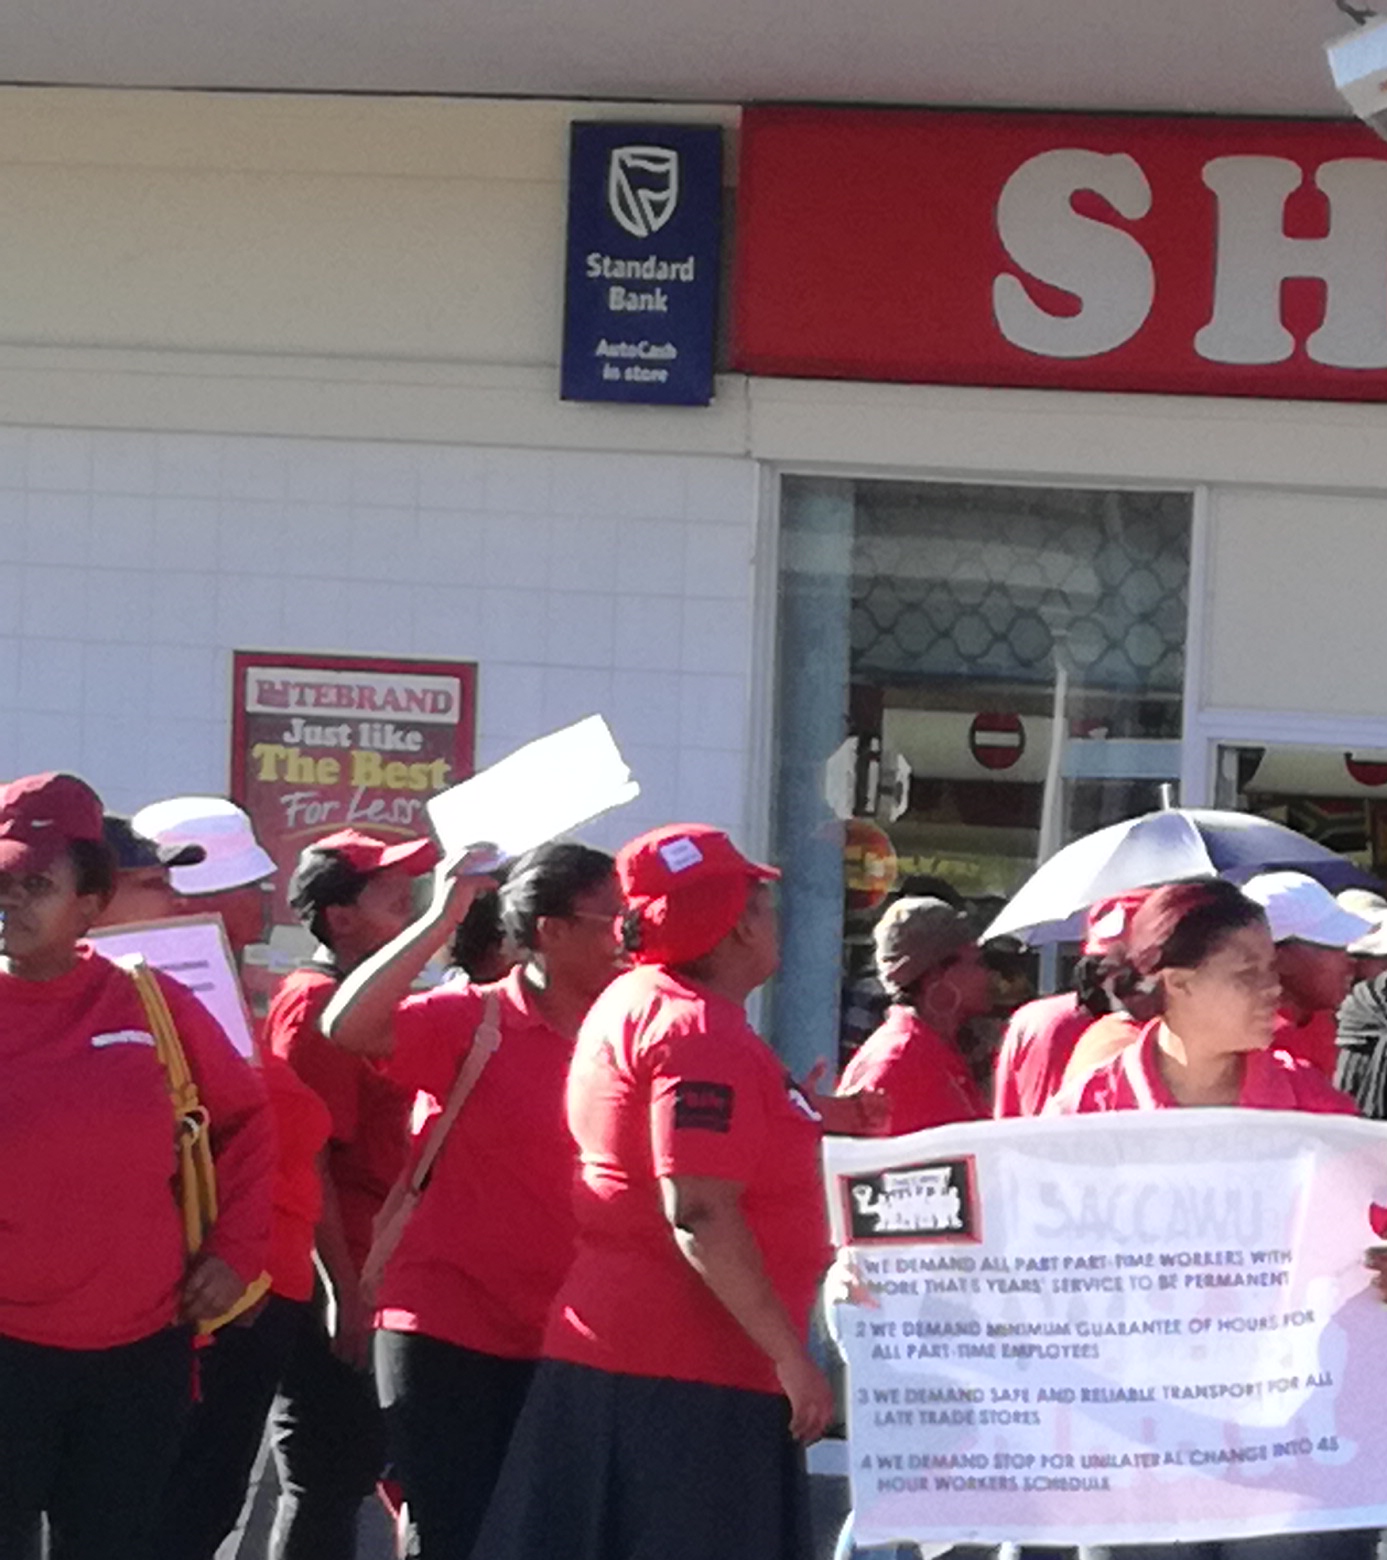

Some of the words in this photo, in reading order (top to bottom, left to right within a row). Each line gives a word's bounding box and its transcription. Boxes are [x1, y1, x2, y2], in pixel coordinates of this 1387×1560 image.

[585, 252, 695, 282] Standard
[608, 285, 668, 312] Bank
[595, 337, 678, 360] AutoCash
[602, 362, 621, 380] in
[624, 364, 669, 383] store
[283, 718, 352, 748] Just
[358, 722, 424, 752] like
[252, 743, 341, 785] The
[350, 749, 452, 791] Best
[280, 791, 341, 828] For
[345, 785, 421, 825] Less
[865, 1258, 889, 1273] WE
[896, 1256, 976, 1273] DEMAND
[980, 1256, 1010, 1272] ALL
[1014, 1255, 1060, 1271] PART
[1160, 1250, 1245, 1267] WORKERS
[1250, 1249, 1293, 1265] WITH
[868, 1278, 919, 1296] MORE
[1051, 1274, 1124, 1294] SERVICE
[1129, 1274, 1153, 1292] TO
[1158, 1273, 1179, 1291] BE
[1184, 1270, 1290, 1289] PERMANENT
[870, 1320, 897, 1338] WE
[902, 1320, 982, 1338] DEMAND
[986, 1321, 1072, 1338] MINIMUM
[1076, 1317, 1183, 1338] GUARANTEE
[1187, 1317, 1212, 1335] OF
[1217, 1313, 1279, 1333] HOURS
[1283, 1309, 1316, 1328] FOR
[871, 1343, 901, 1360] ALL
[1001, 1342, 1101, 1360] EMPLOYEES
[873, 1388, 900, 1404] WE
[904, 1388, 985, 1404] DEMAND
[989, 1387, 1030, 1403] SAFE
[1035, 1387, 1076, 1404] AND
[1080, 1386, 1156, 1403] RELIABLE
[1161, 1381, 1263, 1400] TRANSPORT
[1267, 1375, 1299, 1394] FOR
[1305, 1370, 1334, 1388] ALL
[873, 1409, 913, 1426] LATE
[918, 1409, 976, 1426] TRADE
[979, 1409, 1041, 1426] STORES
[877, 1453, 904, 1470] WE
[908, 1453, 990, 1470] DEMAND
[993, 1452, 1037, 1470] STOP
[1041, 1453, 1076, 1469] FOR
[1188, 1444, 1268, 1467] CHANGE
[1272, 1436, 1314, 1458] INTO
[876, 1476, 929, 1493] HOUR
[934, 1475, 1019, 1492] WORKERS
[1022, 1475, 1111, 1492] SCHEDULE
